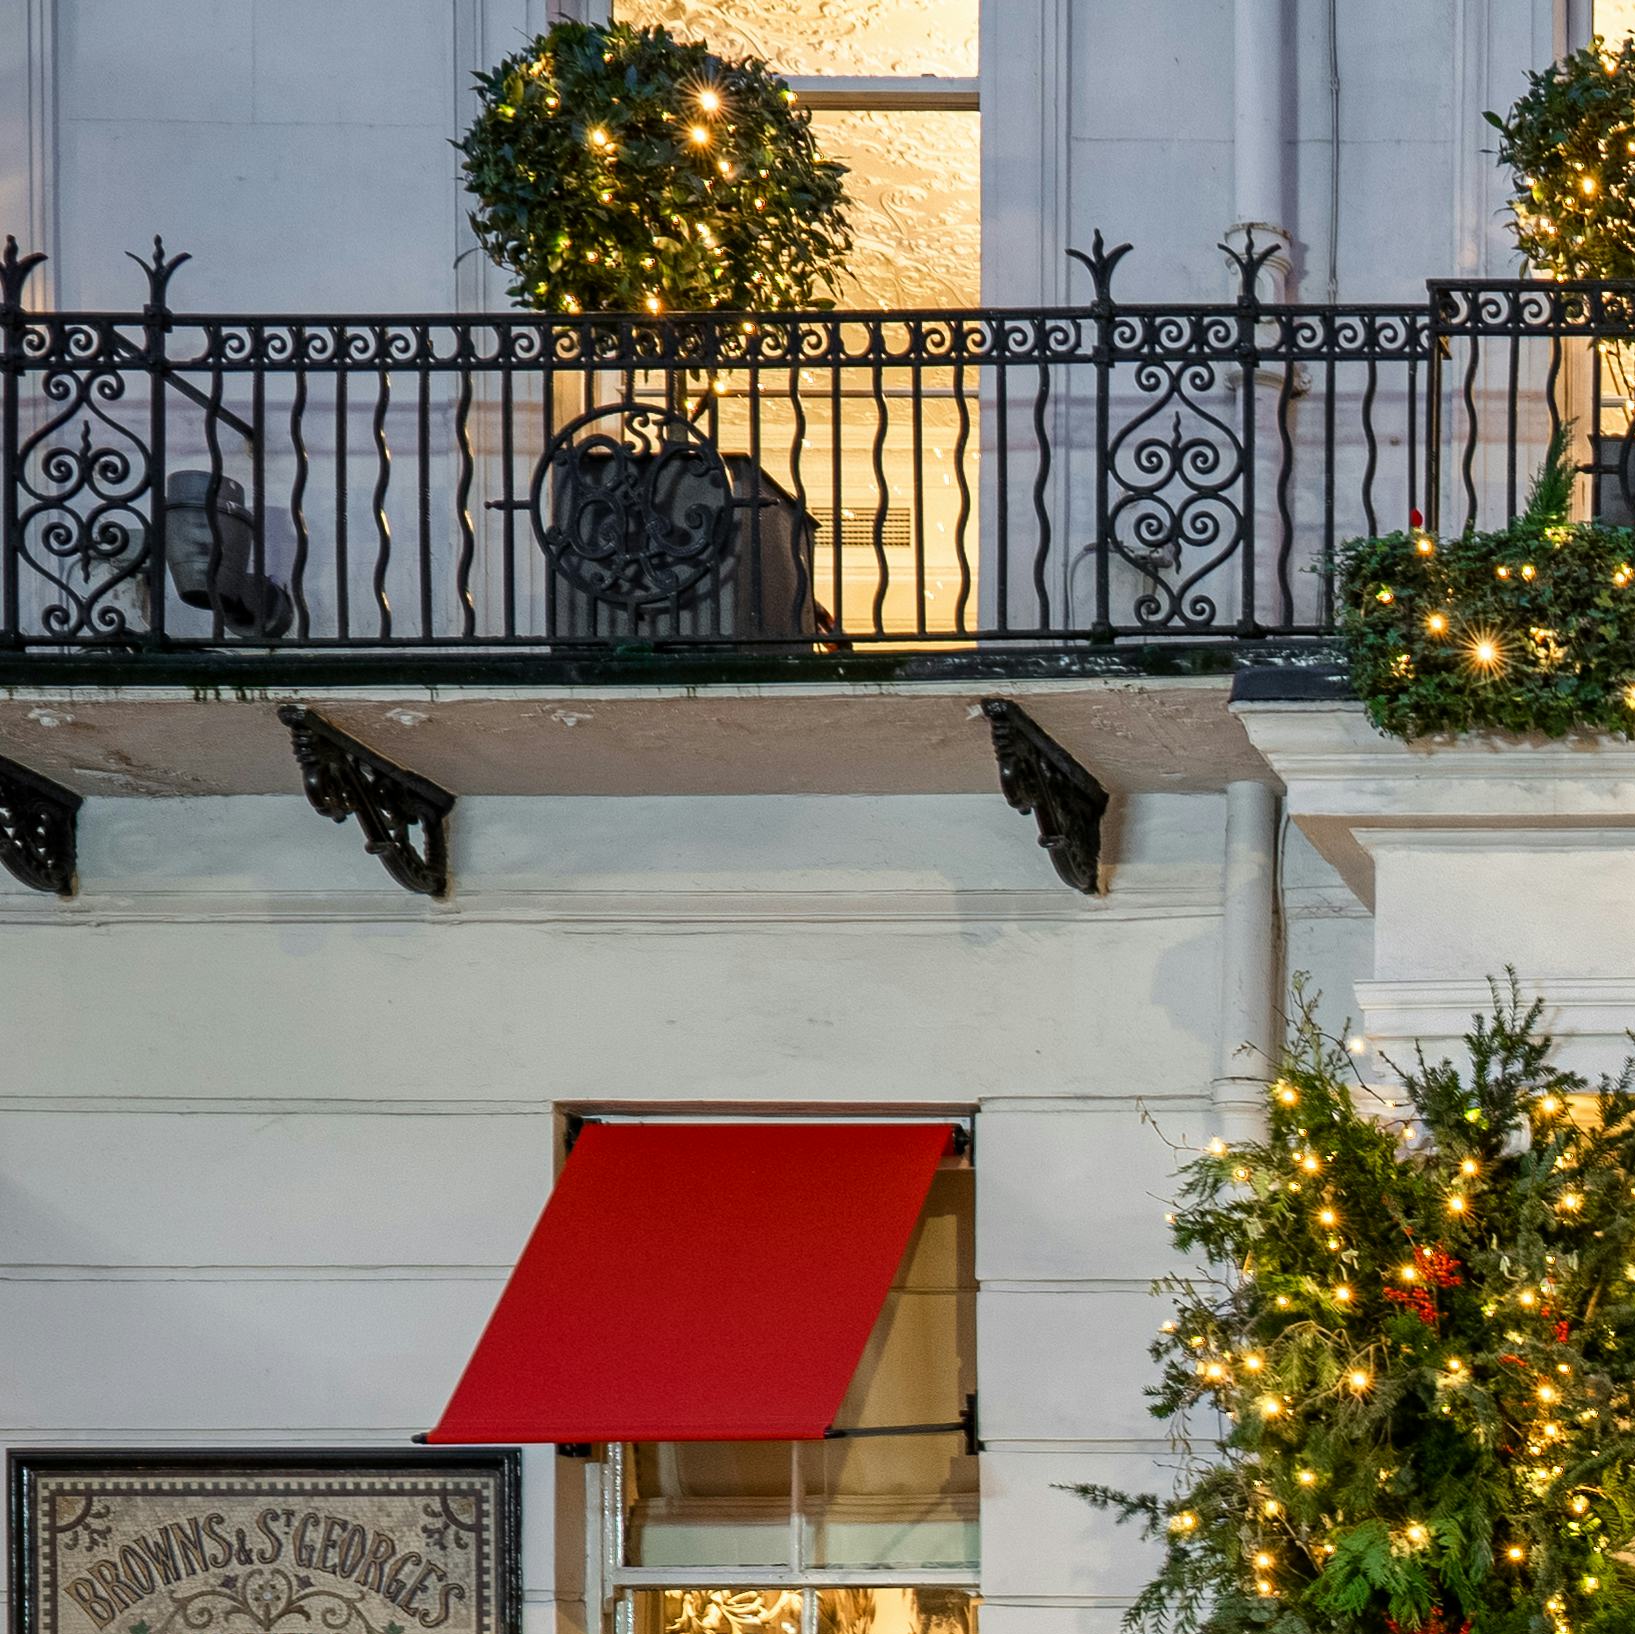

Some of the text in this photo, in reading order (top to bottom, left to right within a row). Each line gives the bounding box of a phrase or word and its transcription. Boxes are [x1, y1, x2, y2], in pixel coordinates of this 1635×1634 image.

[63, 1511, 233, 1631] BROWNS
[234, 1527, 255, 1566] &
[291, 1511, 466, 1629] GEORGES
